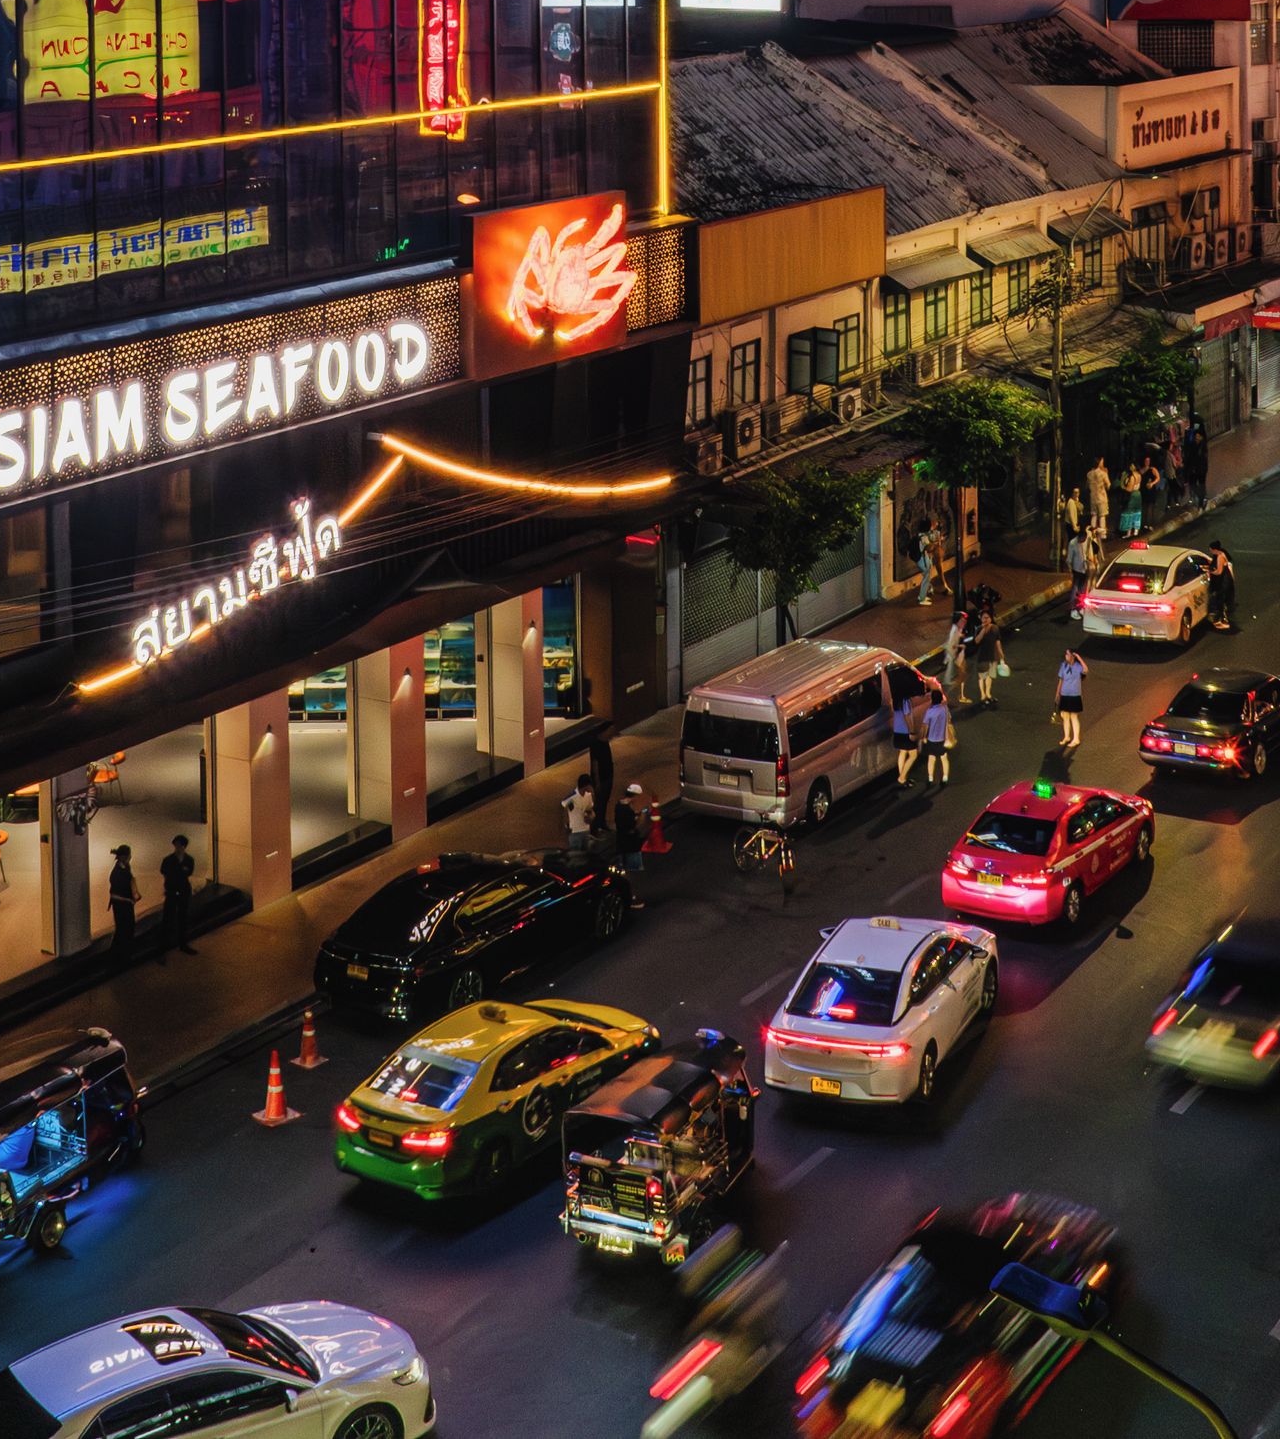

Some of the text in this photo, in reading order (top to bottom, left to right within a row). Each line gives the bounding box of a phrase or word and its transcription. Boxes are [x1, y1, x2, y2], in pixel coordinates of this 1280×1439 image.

[165, 322, 428, 444] SEAFOOD
[132, 497, 342, 663] สยามซีฟู้ด
